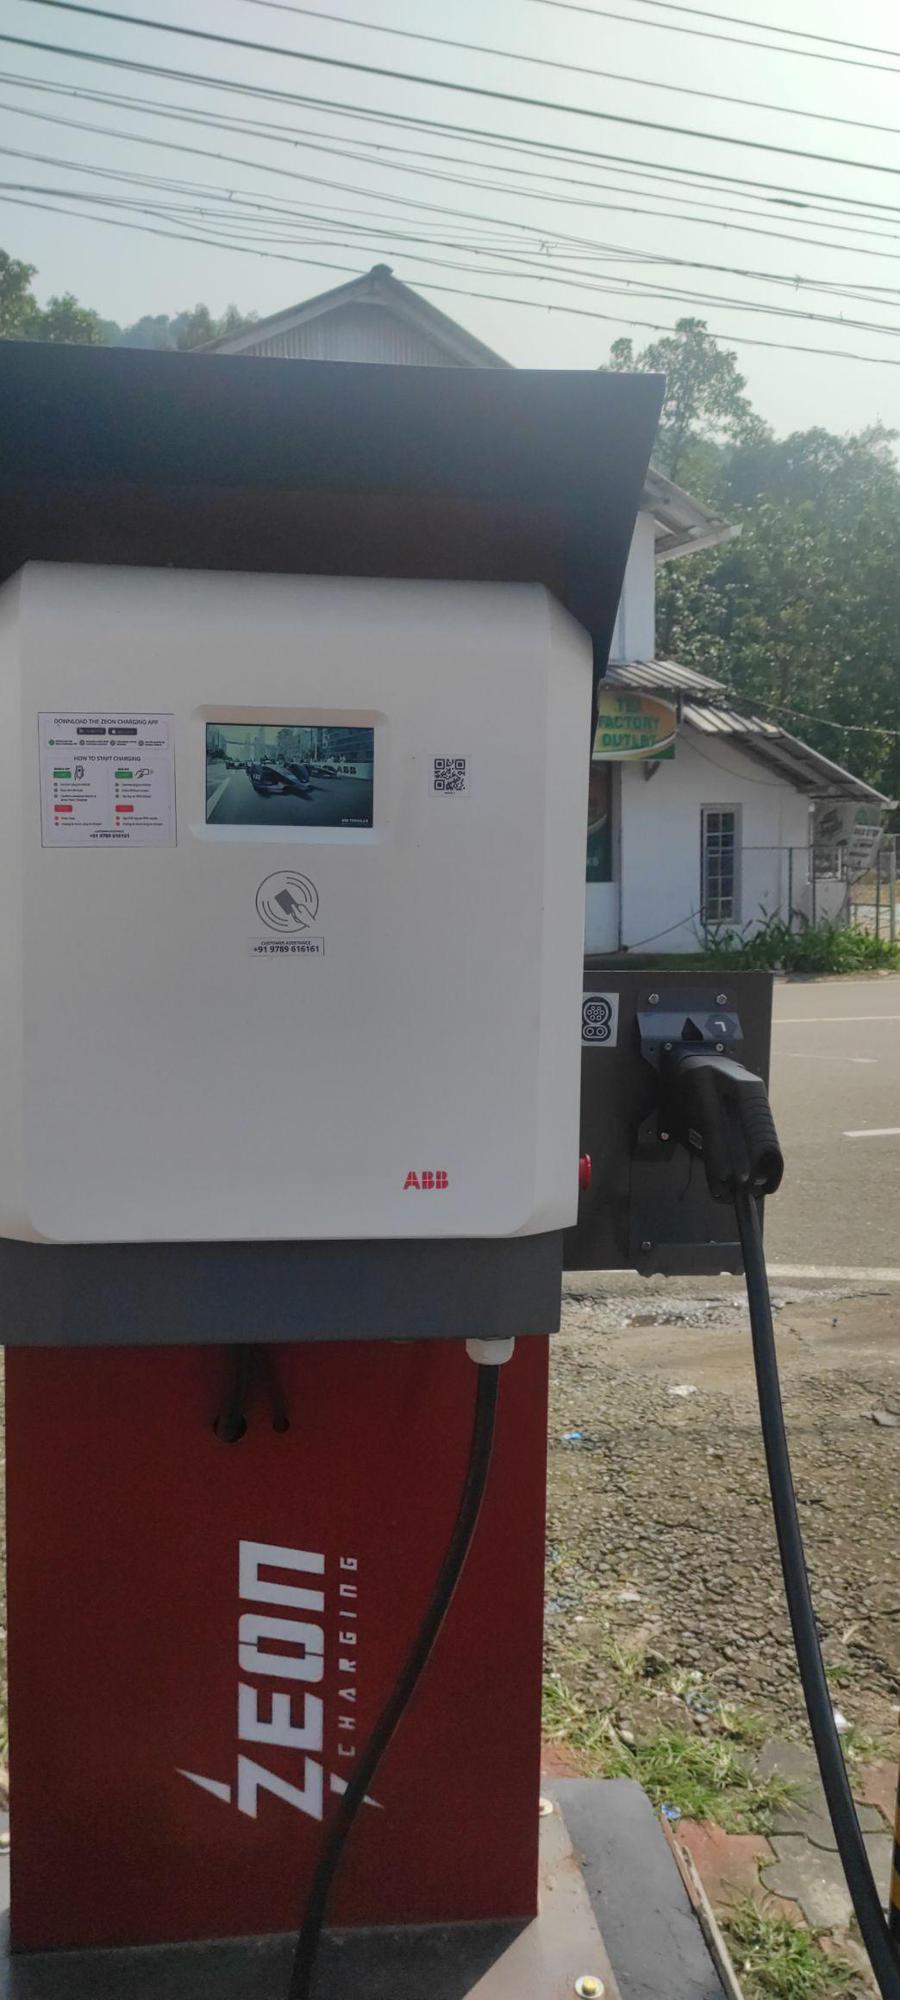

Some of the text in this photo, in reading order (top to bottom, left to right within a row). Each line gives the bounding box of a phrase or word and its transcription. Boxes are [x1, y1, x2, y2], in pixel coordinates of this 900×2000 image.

[599, 715, 659, 729] FACTORY
[602, 733, 656, 747] OUTLET
[254, 945, 319, 953] +91 9789 616161
[402, 1170, 449, 1190] ABB
[338, 1556, 358, 1757] CHARGING
[237, 1540, 325, 1822] ZEON
